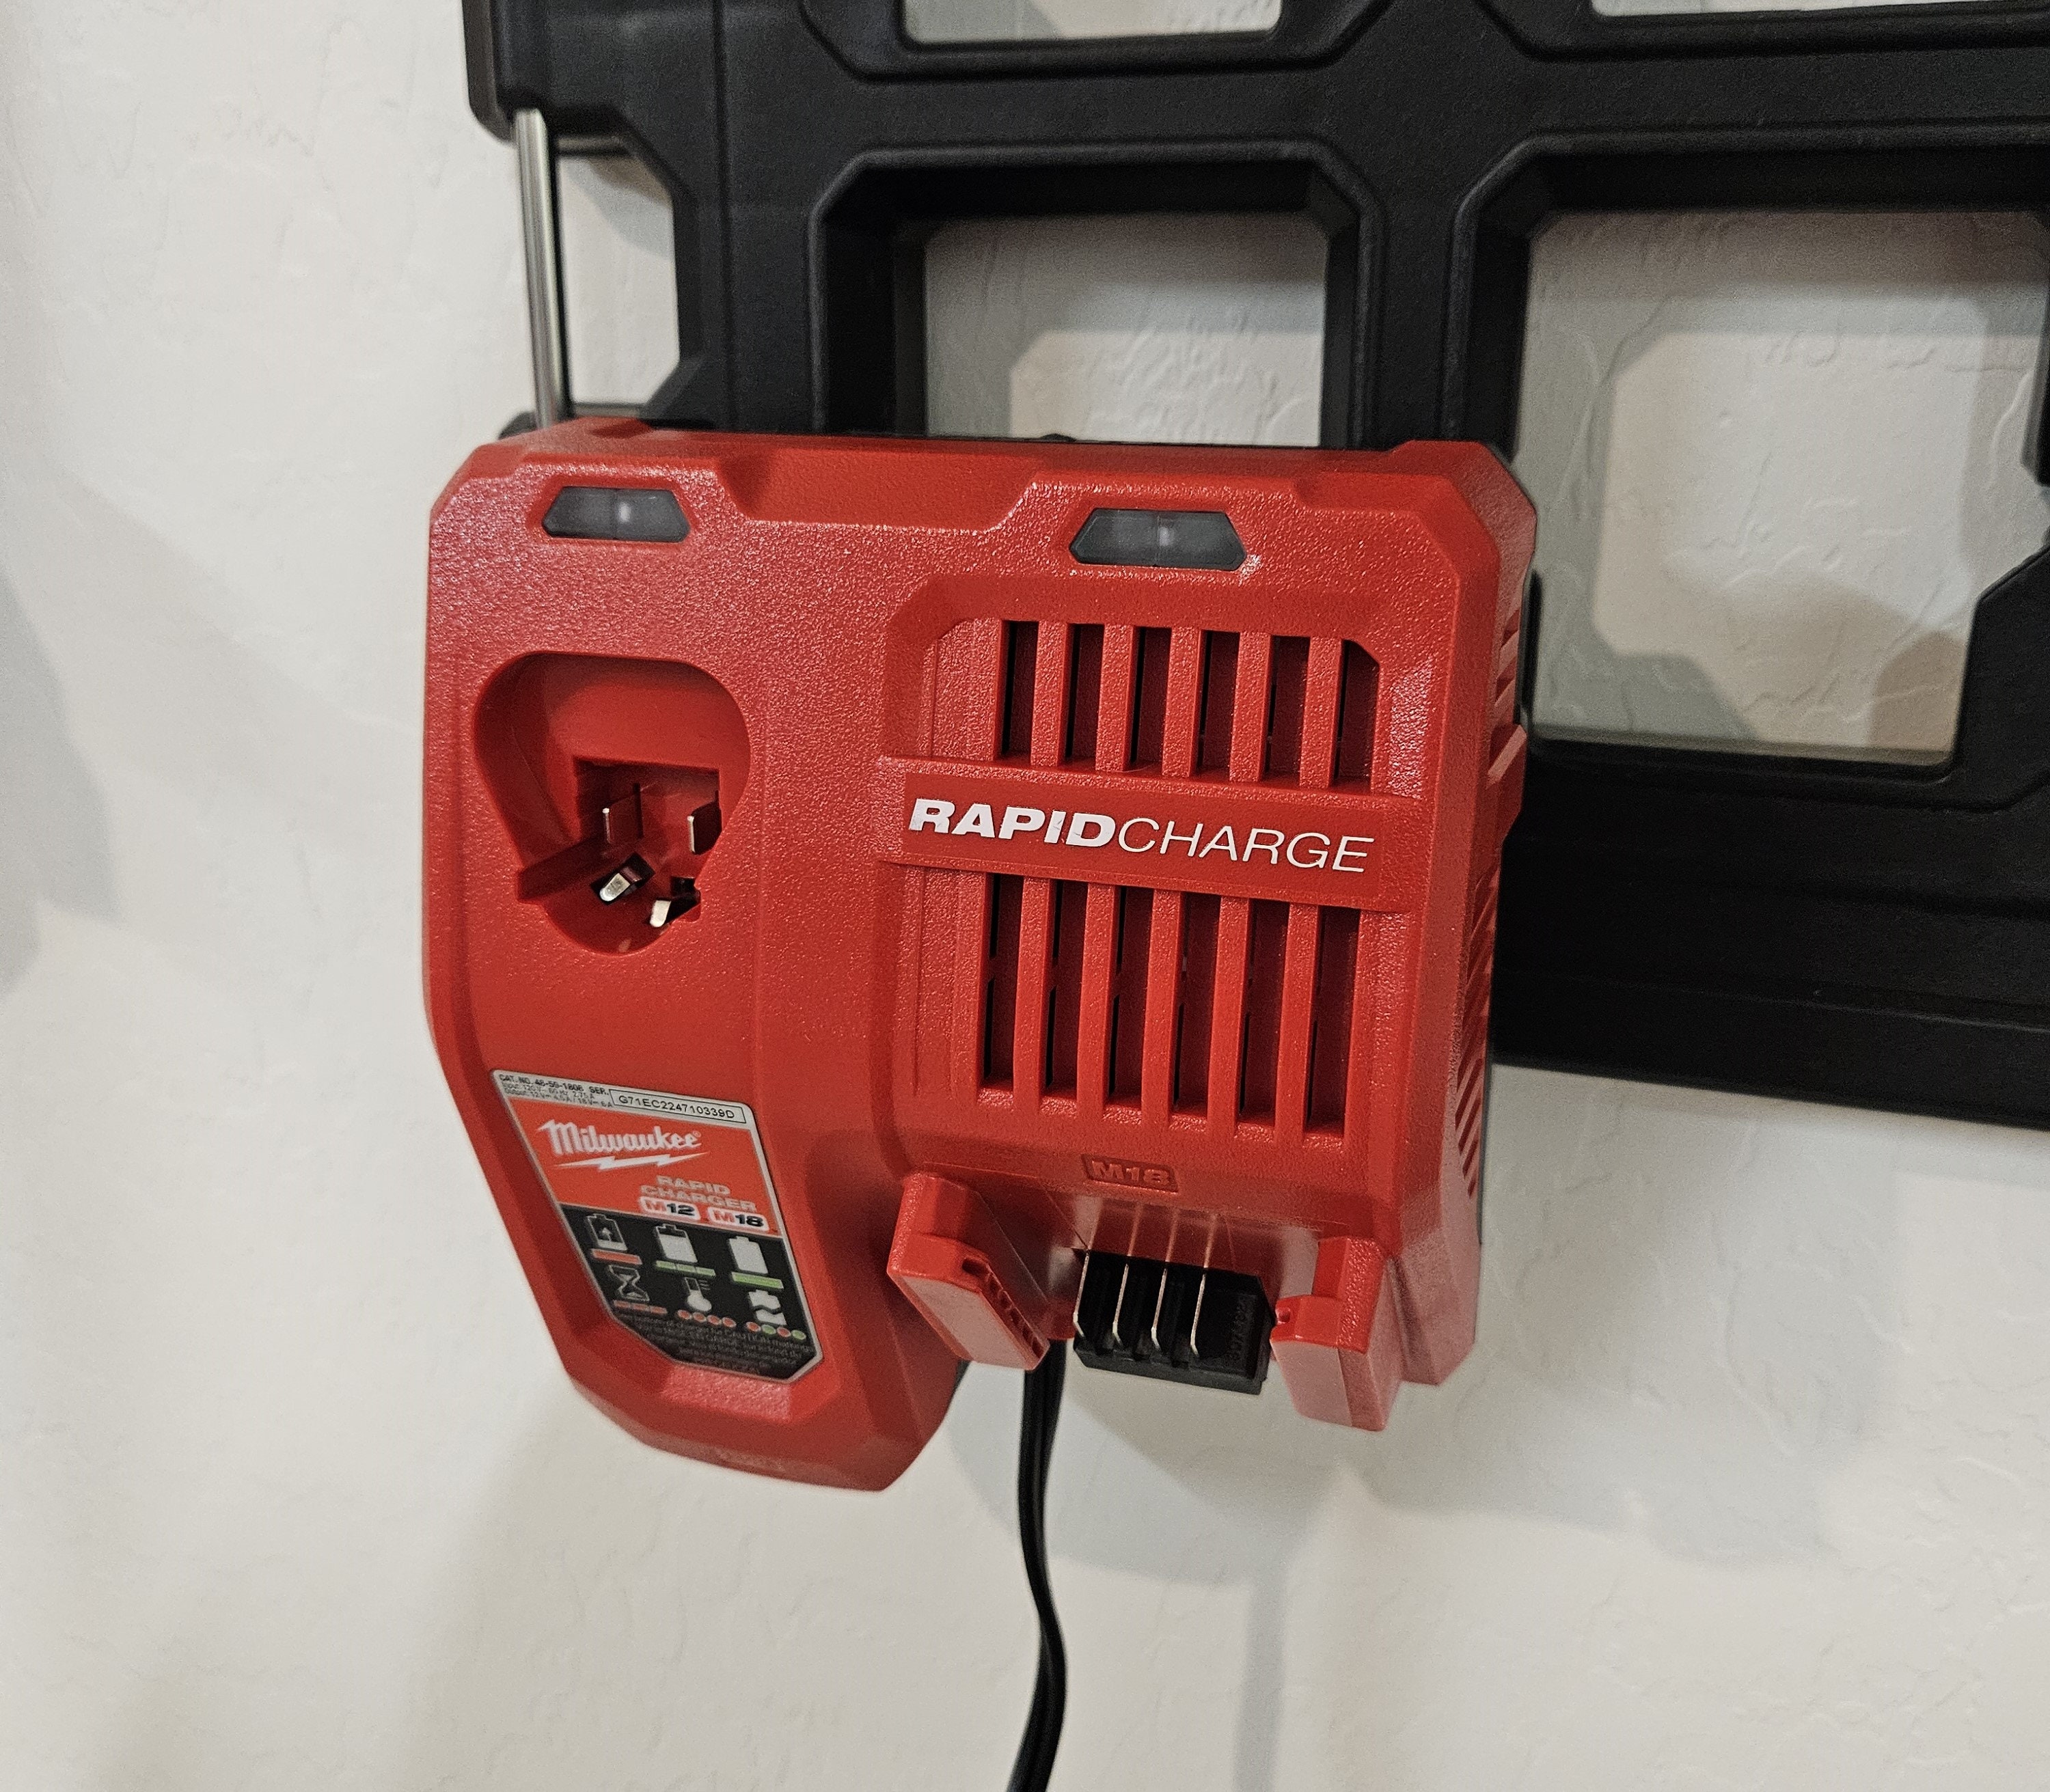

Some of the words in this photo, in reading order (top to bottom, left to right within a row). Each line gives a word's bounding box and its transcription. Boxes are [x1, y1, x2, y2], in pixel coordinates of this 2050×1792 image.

[908, 798, 1375, 872] RAPIDCHARGE
[618, 1095, 735, 1118] G71EC224710339D
[536, 1119, 702, 1155] Milwaukee
[656, 1175, 731, 1195] RAPID
[1092, 1161, 1169, 1185] M18
[640, 1185, 756, 1213] CHARGER
[644, 1199, 696, 1217] M12
[713, 1209, 765, 1227] M18
